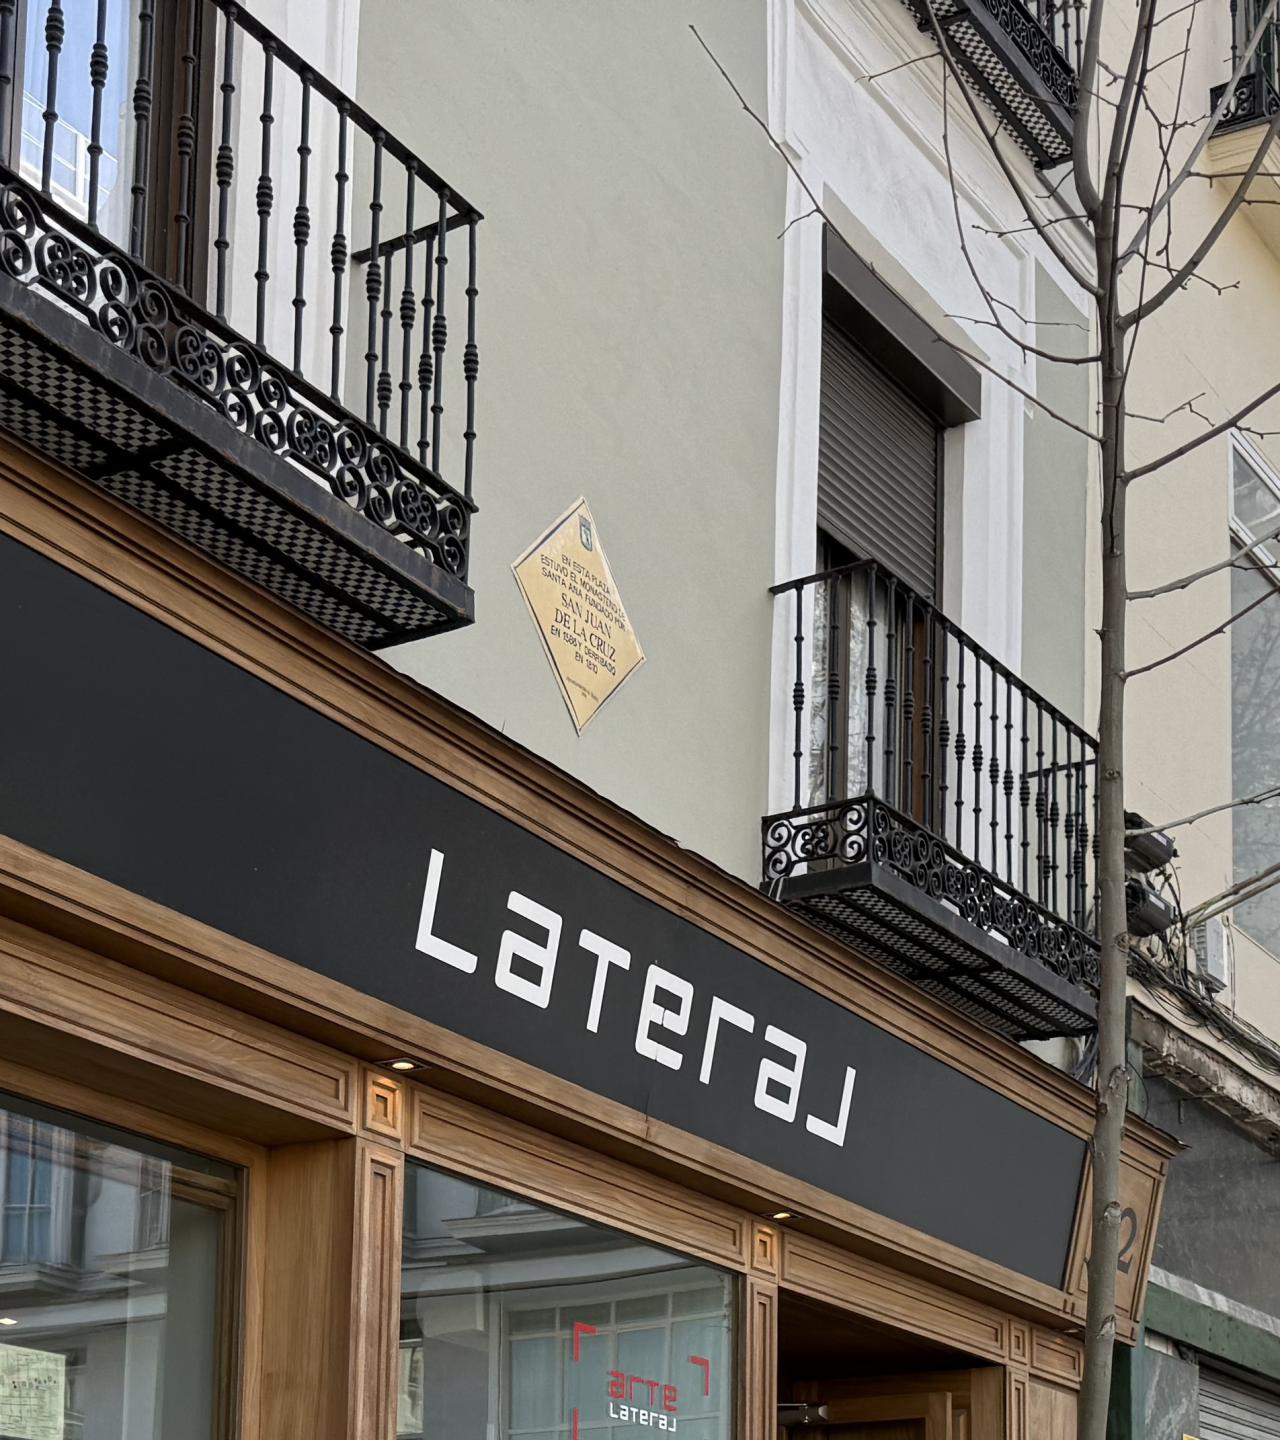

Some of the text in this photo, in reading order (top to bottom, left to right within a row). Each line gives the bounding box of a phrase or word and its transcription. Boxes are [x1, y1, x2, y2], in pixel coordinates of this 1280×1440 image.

[554, 607, 616, 663] DE LA CRUZ
[561, 592, 611, 640] SAN JUAN
